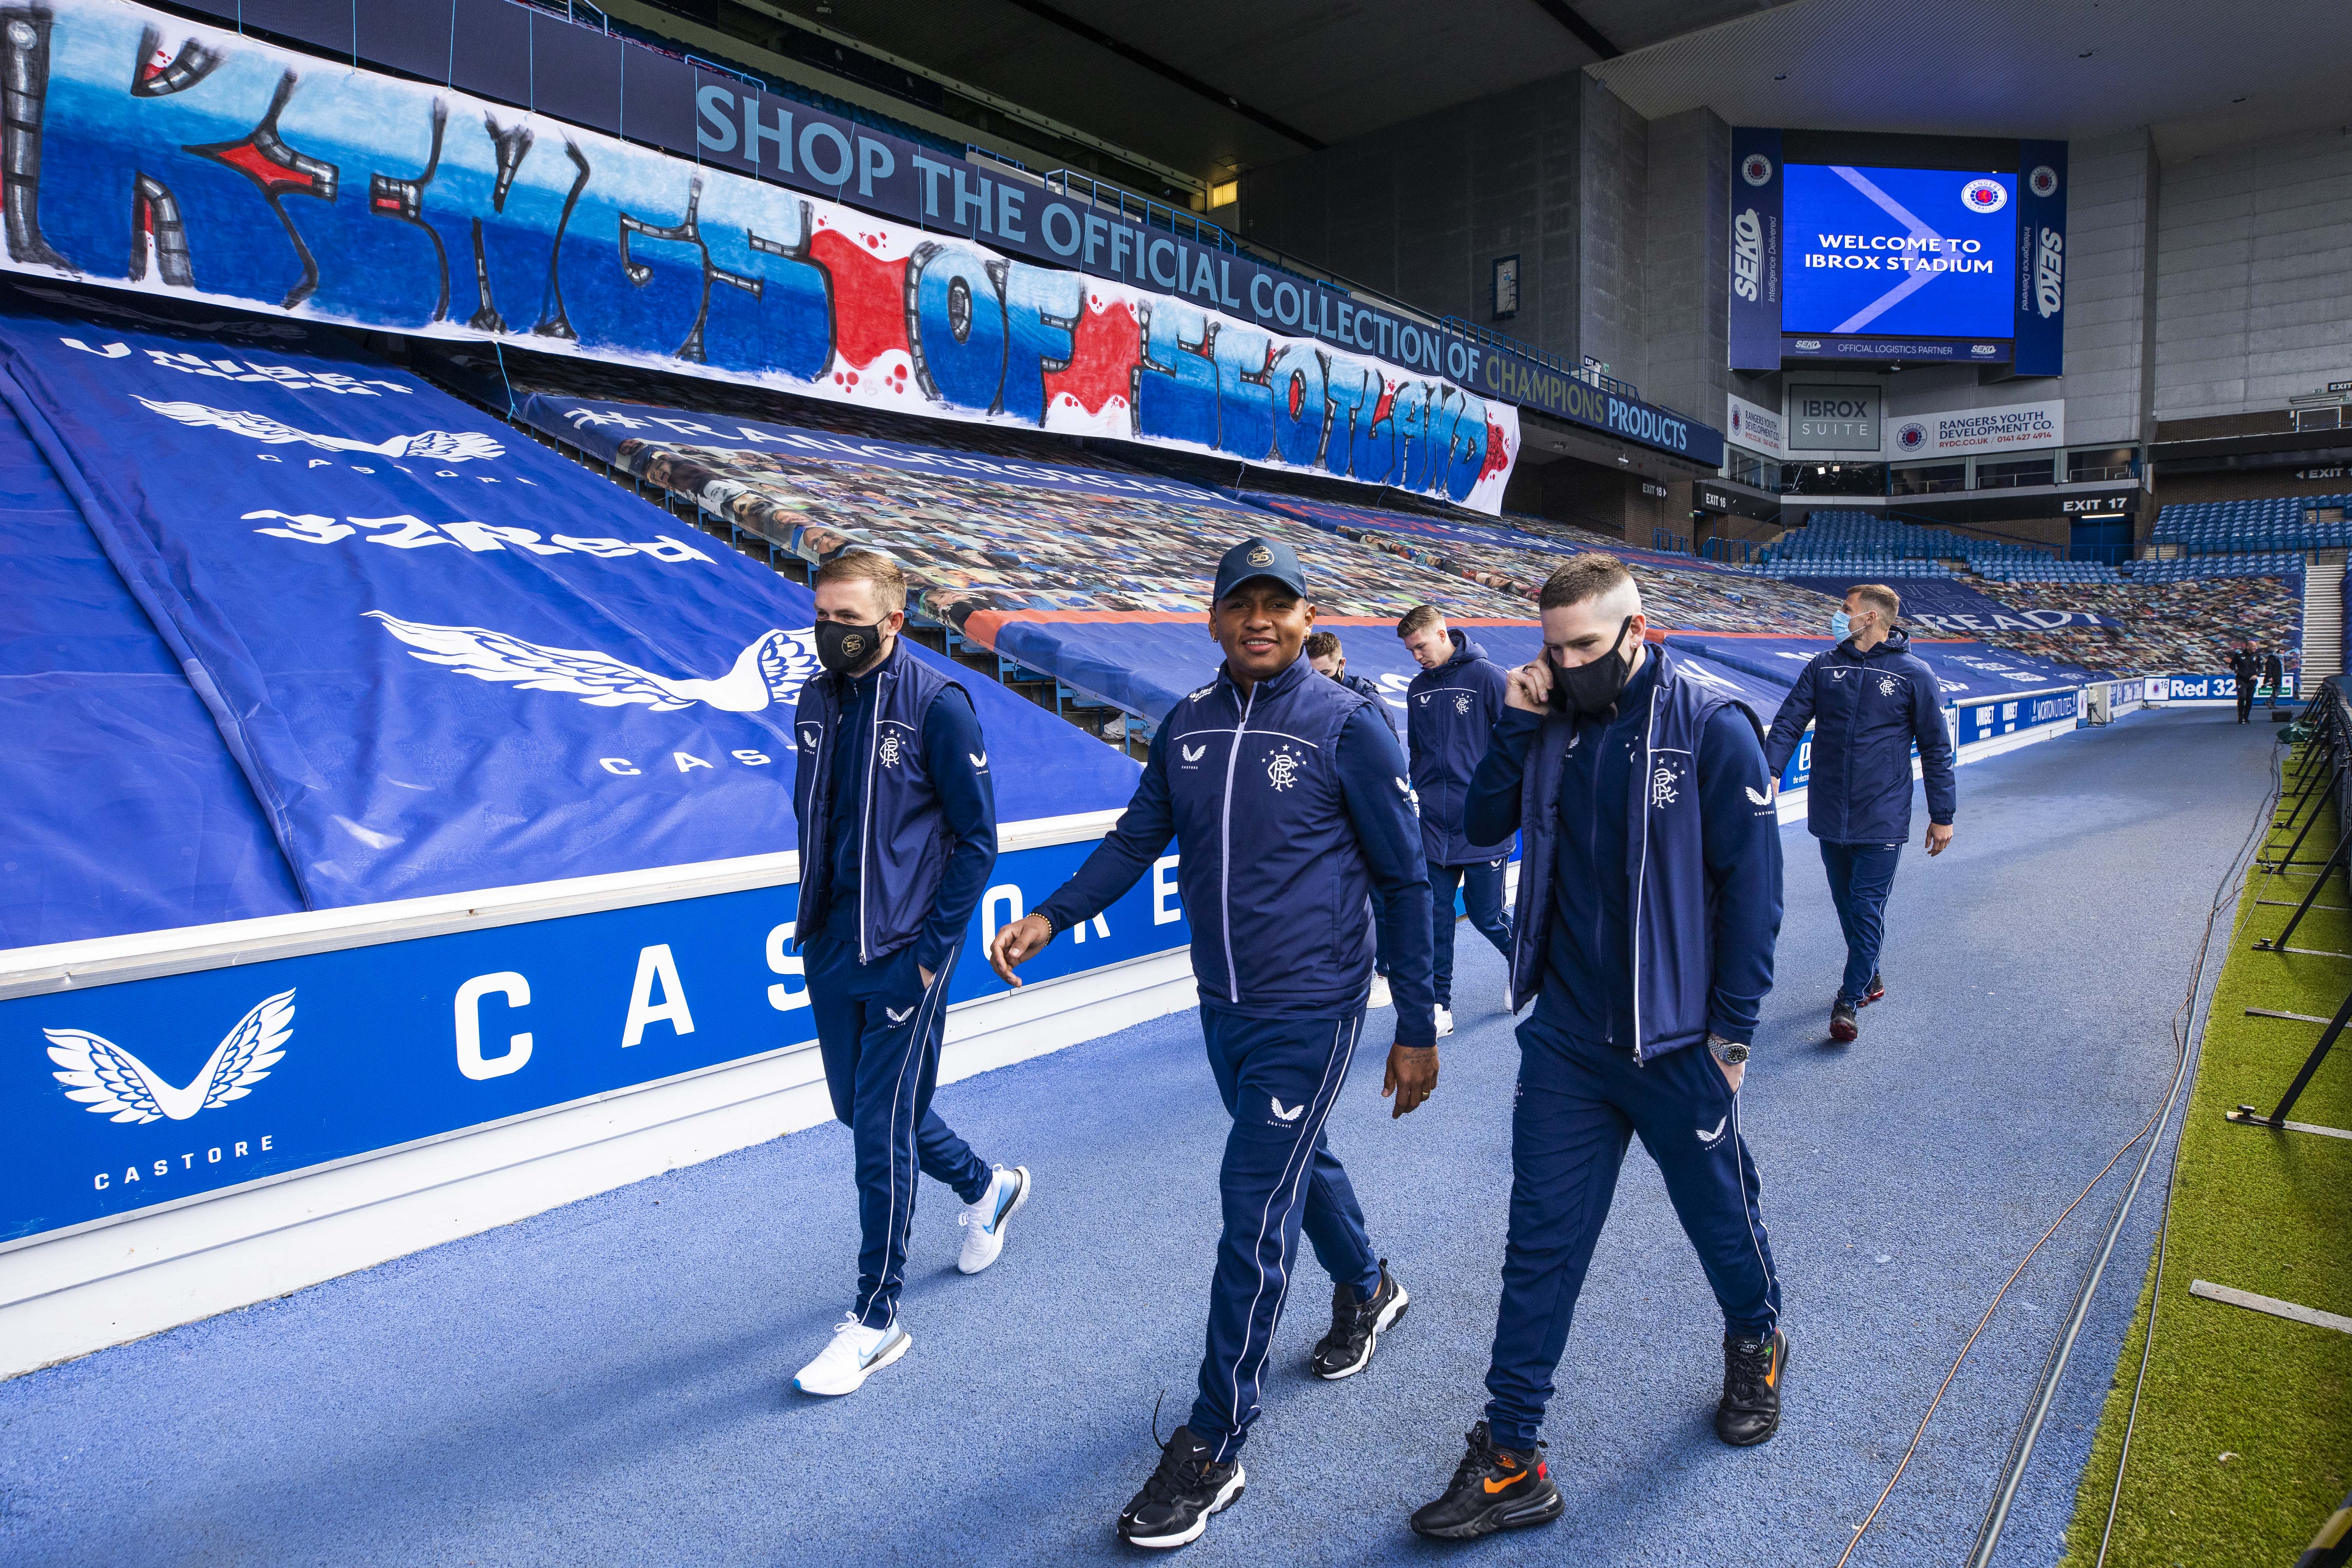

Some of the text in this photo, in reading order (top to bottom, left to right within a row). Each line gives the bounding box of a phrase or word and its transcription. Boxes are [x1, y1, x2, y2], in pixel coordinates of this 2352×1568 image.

[1968, 181, 2001, 191] RANGERS
[1818, 234, 1981, 253] WELCOME TO
[2022, 226, 2031, 271] Intelligence
[1734, 208, 1760, 302] SEKO
[1805, 253, 1993, 274] IBROX STADIUM
[697, 84, 1687, 451] SHOP THE OFFICIAL COLLECTION OF CHAMPIONS PRODUCTS
[2041, 227, 2062, 318] SEKO
[1768, 256, 1777, 302] Intelligence
[905, 239, 1087, 428] OF
[1795, 340, 1821, 350] SEKO
[1838, 344, 1953, 355] OFFICIAL LOGISTICS PARTNER
[1971, 345, 1996, 354] SEKO
[1585, 358, 1594, 366] EXIT
[1803, 400, 1867, 418] IBROX
[1745, 410, 1777, 431] RANGERS YOUTH
[1940, 410, 2044, 430] RANGERS YOUTH
[1745, 421, 1773, 439] DEVELOPMENT
[1802, 423, 1868, 436] SUITE
[1940, 420, 2054, 440] DEVELOPMENT CO.
[1939, 438, 1988, 448] RYDC.CO.UK
[256, 454, 538, 486] CASTORE
[2309, 468, 2344, 479] EXIT
[1643, 482, 1662, 497] EXIT 16
[1706, 493, 1726, 508] EXIT 16
[2063, 498, 2127, 512] EXIT 17
[2160, 680, 2168, 689] 16
[2171, 679, 2208, 697] Red
[2213, 679, 2236, 696] 32
[1976, 705, 1994, 727] UNIBET
[2003, 702, 2018, 722] UNIBET
[2037, 699, 2055, 721] WORTON
[93, 1134, 274, 1191] CASTORE
